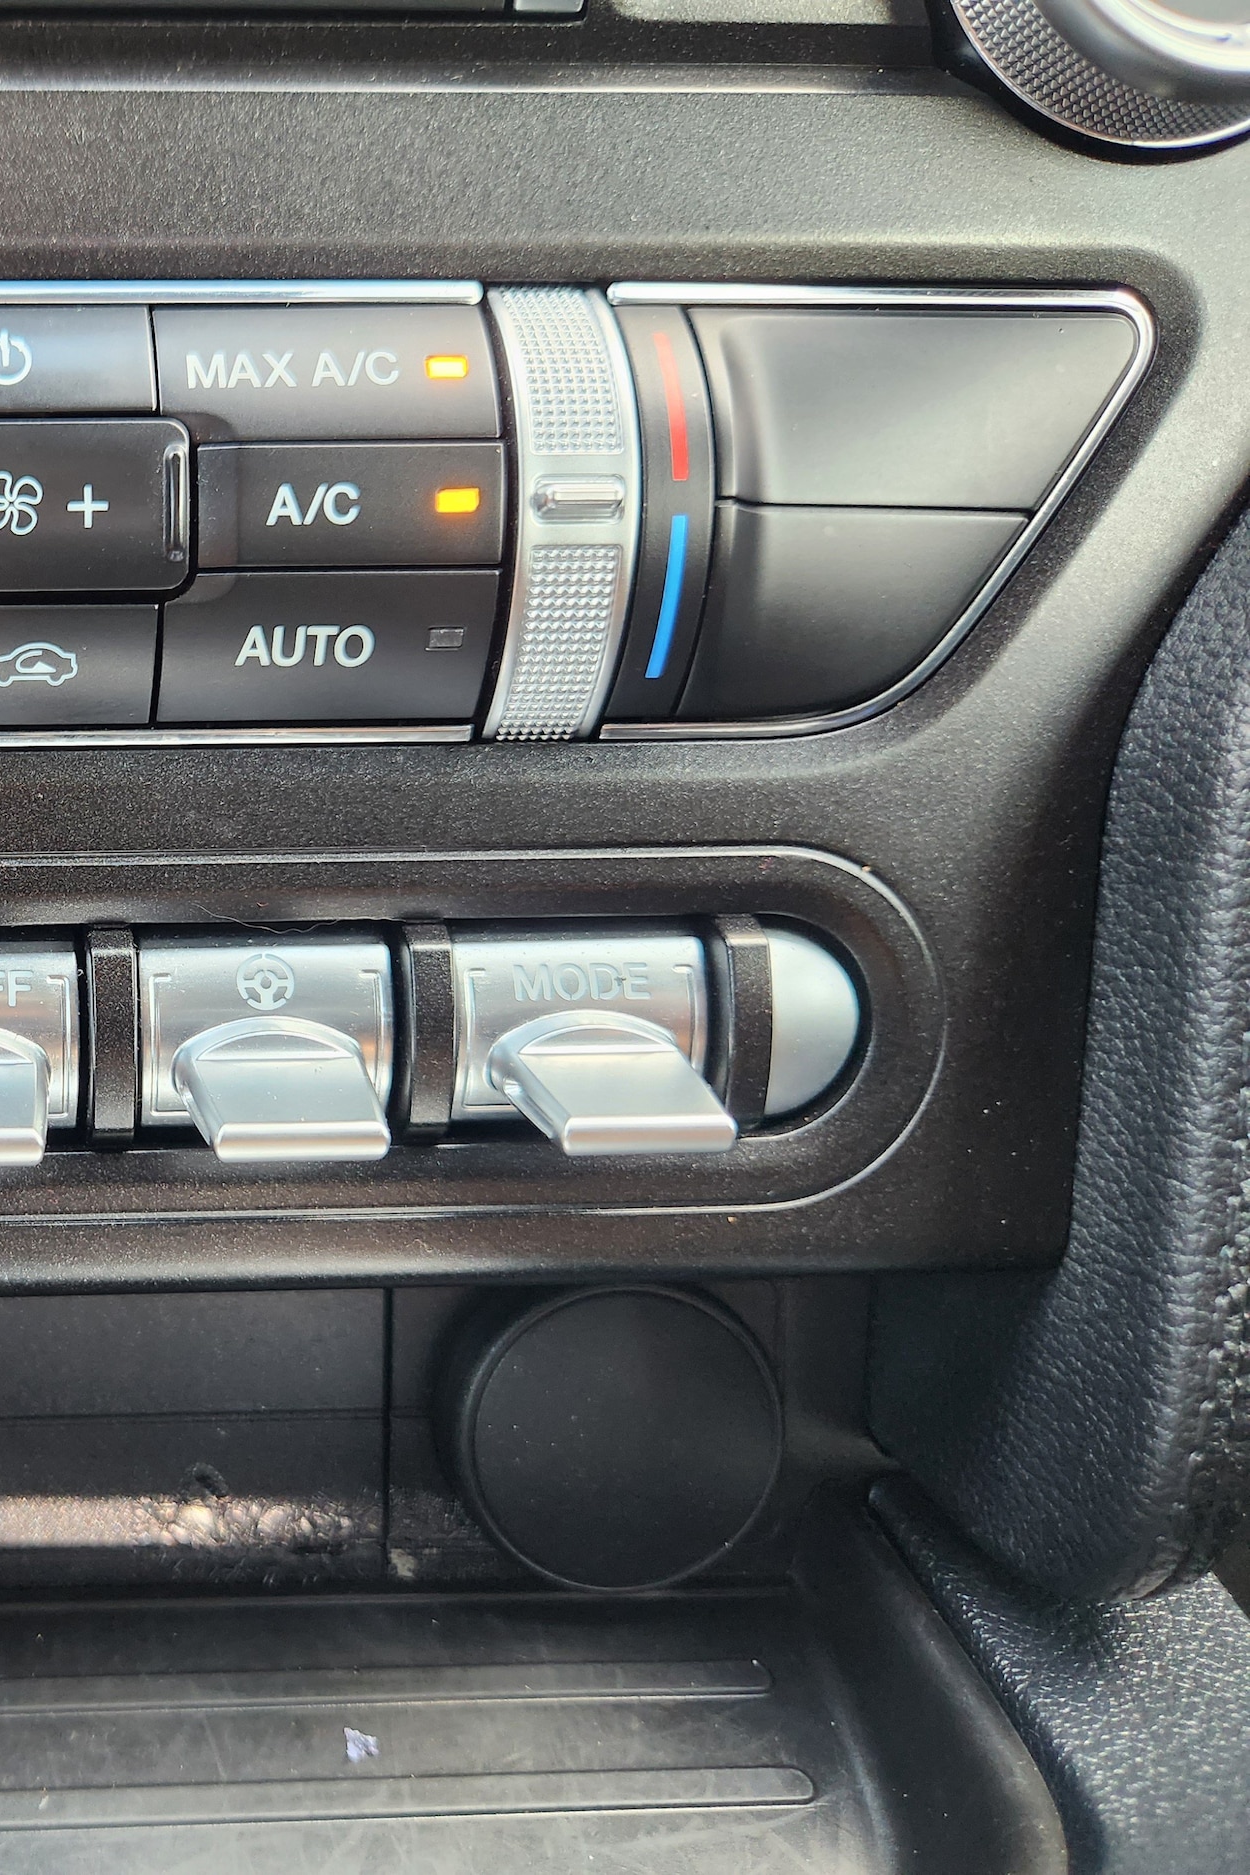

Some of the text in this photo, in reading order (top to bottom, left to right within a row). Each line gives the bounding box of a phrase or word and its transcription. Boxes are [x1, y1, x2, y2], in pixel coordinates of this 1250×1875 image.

[186, 350, 400, 390] MAX A/C
[266, 482, 362, 527] A/C
[235, 625, 376, 668] AUTO
[512, 961, 652, 1002] MODE
